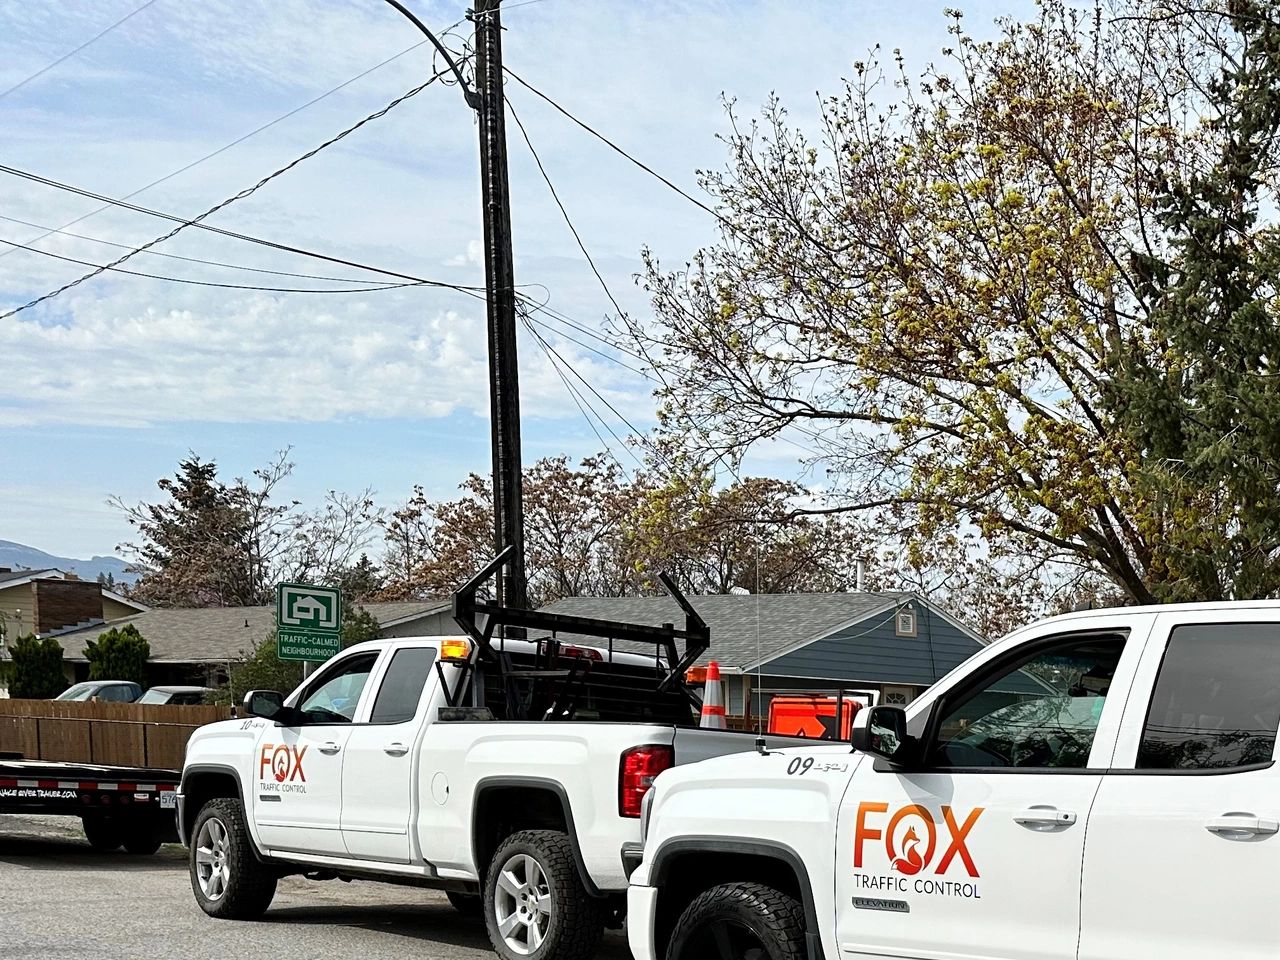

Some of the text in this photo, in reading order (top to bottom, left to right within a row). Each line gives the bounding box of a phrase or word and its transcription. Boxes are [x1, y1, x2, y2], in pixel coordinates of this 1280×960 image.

[280, 635, 338, 646] TRAFFIC-CALMED
[281, 646, 336, 657] NEIGHBOURHOOD
[260, 744, 308, 782] FOX
[787, 757, 814, 775] 09
[260, 783, 306, 793] TRAFFIC CONTROL
[854, 801, 985, 878] FOX
[854, 874, 981, 899] TRAFFIC CONTROL
[855, 900, 905, 909] ELEVATION
